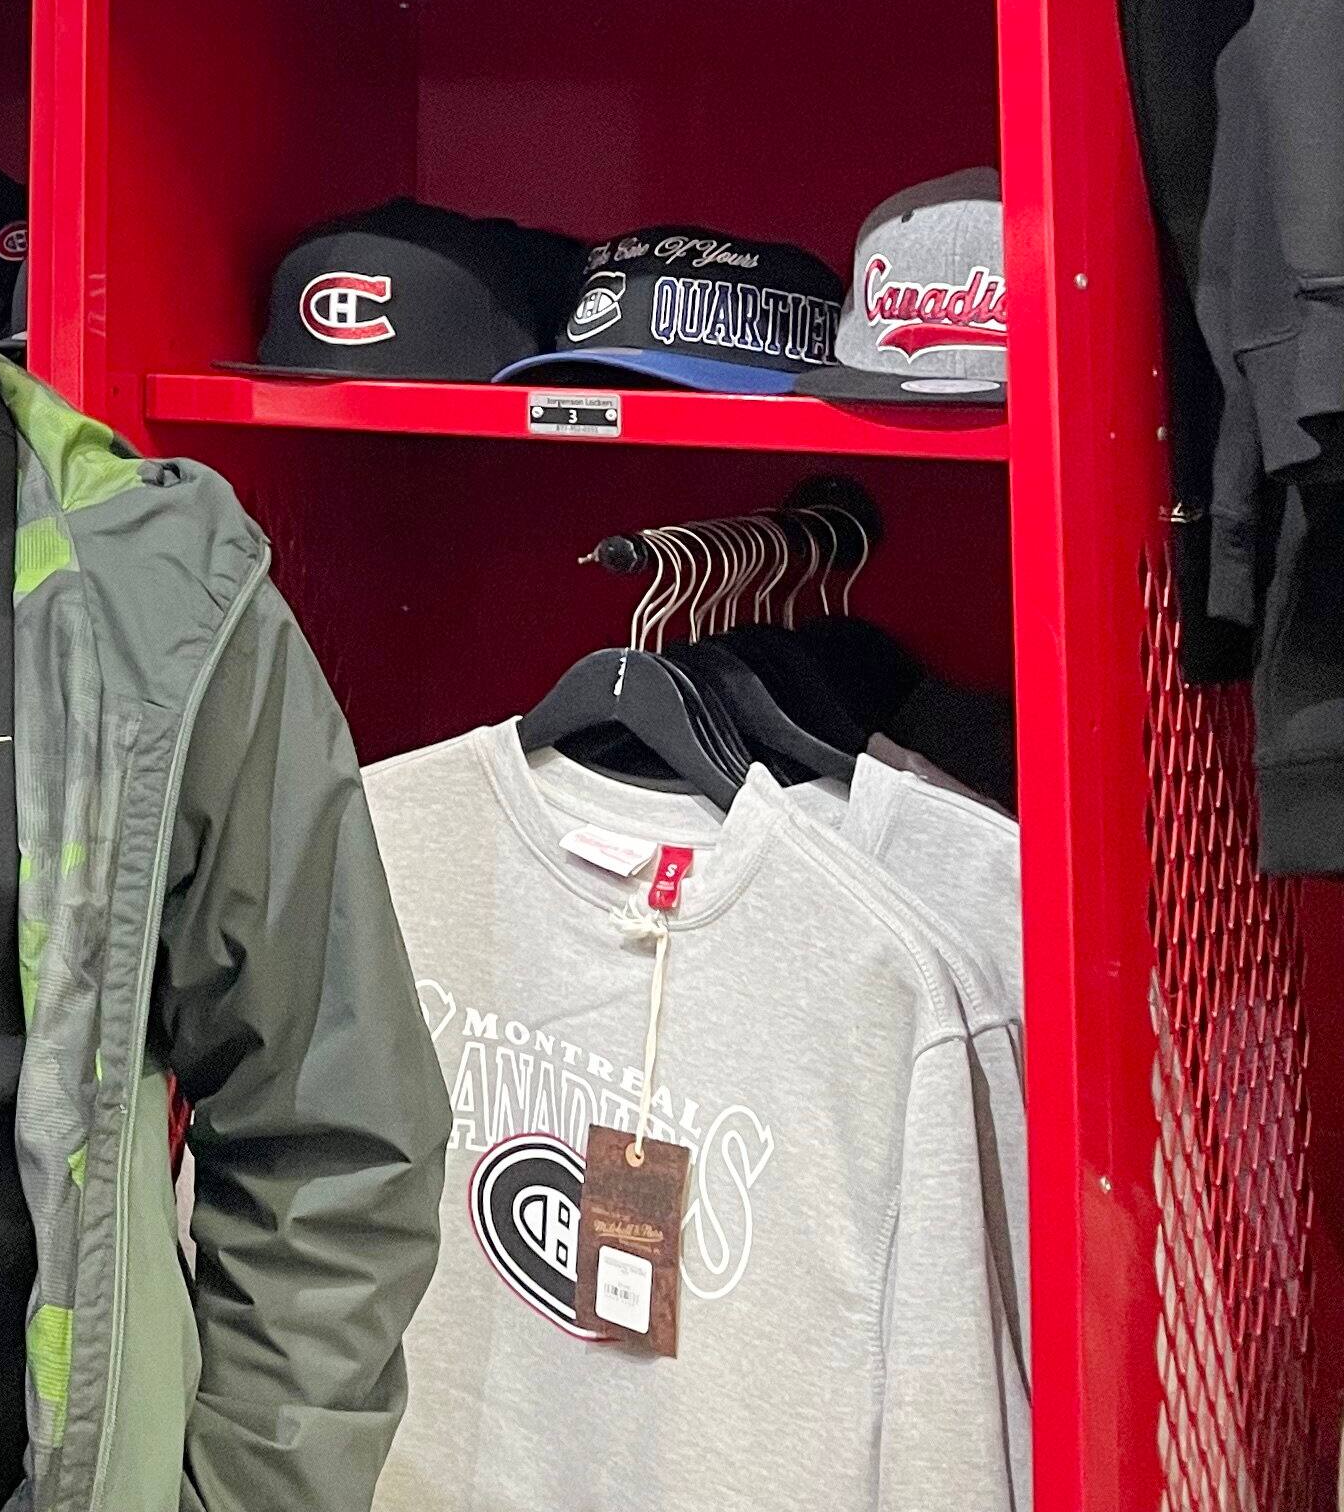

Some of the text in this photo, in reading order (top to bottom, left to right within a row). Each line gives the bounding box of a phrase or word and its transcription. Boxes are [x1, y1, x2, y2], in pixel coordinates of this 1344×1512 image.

[654, 235, 699, 265] Of
[692, 238, 760, 270] Yours
[568, 409, 578, 424] 3
[665, 863, 678, 878] S
[462, 1006, 704, 1139] MONTREAL
